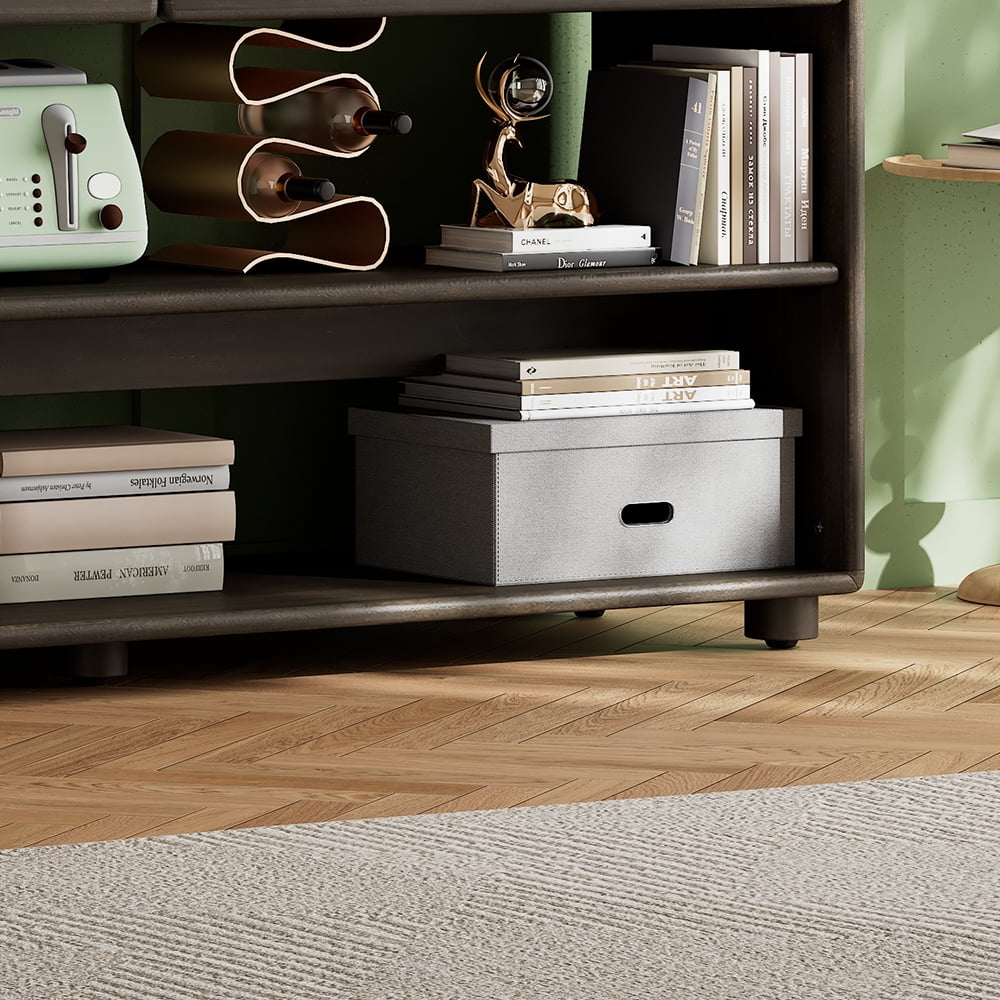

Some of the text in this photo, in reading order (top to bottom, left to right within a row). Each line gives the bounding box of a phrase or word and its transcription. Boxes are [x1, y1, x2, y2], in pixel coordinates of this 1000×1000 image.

[692, 102, 702, 114] 41
[800, 148, 809, 194] Мартин
[521, 238, 550, 246] CHANEL
[558, 258, 574, 268] Dior
[662, 376, 697, 387] ART
[663, 390, 697, 401] ART
[130, 473, 214, 489] Norwegian Folktales
[74, 569, 112, 581] PEWTER
[120, 566, 169, 578] AMERICAN
